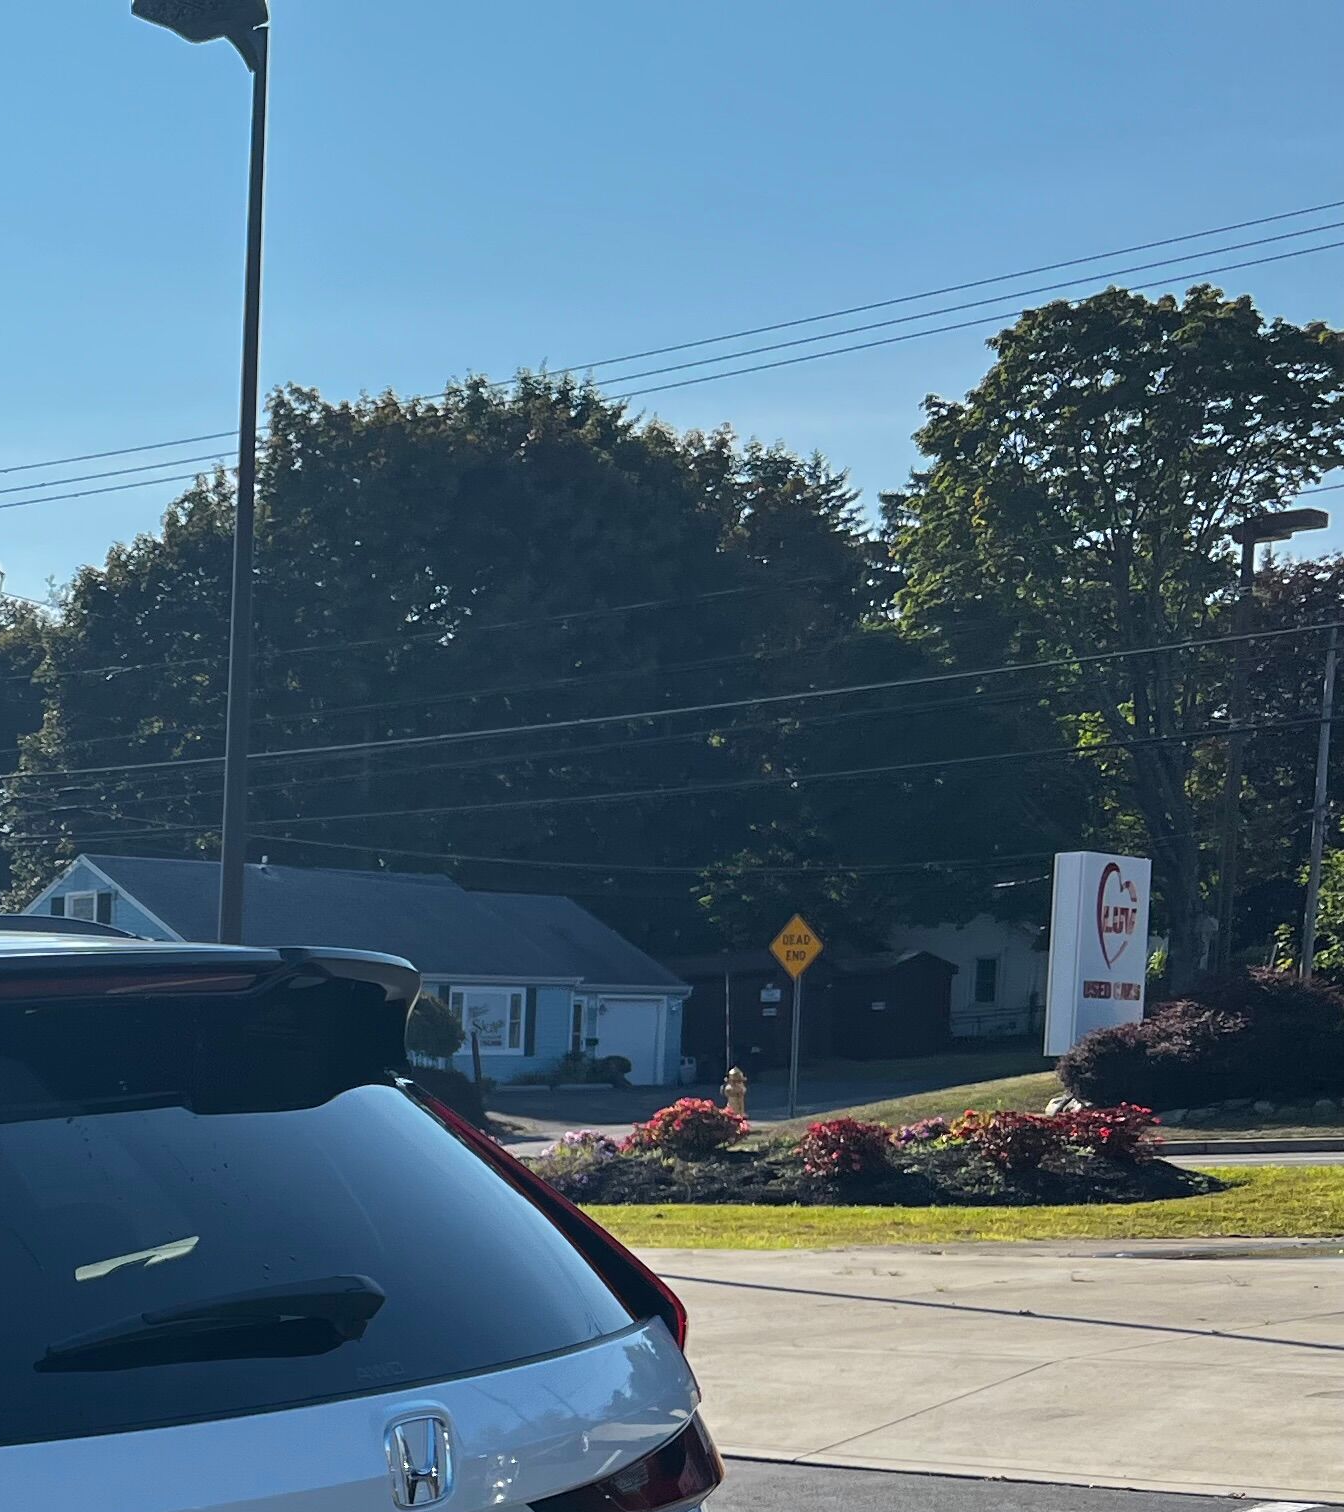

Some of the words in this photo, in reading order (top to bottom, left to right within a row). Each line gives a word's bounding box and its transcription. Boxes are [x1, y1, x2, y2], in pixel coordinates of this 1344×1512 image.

[1103, 905, 1137, 935] LUV
[782, 934, 810, 946] DEAD
[786, 950, 807, 961] END
[1083, 981, 1112, 999] USED
[1113, 981, 1141, 1001] CARS
